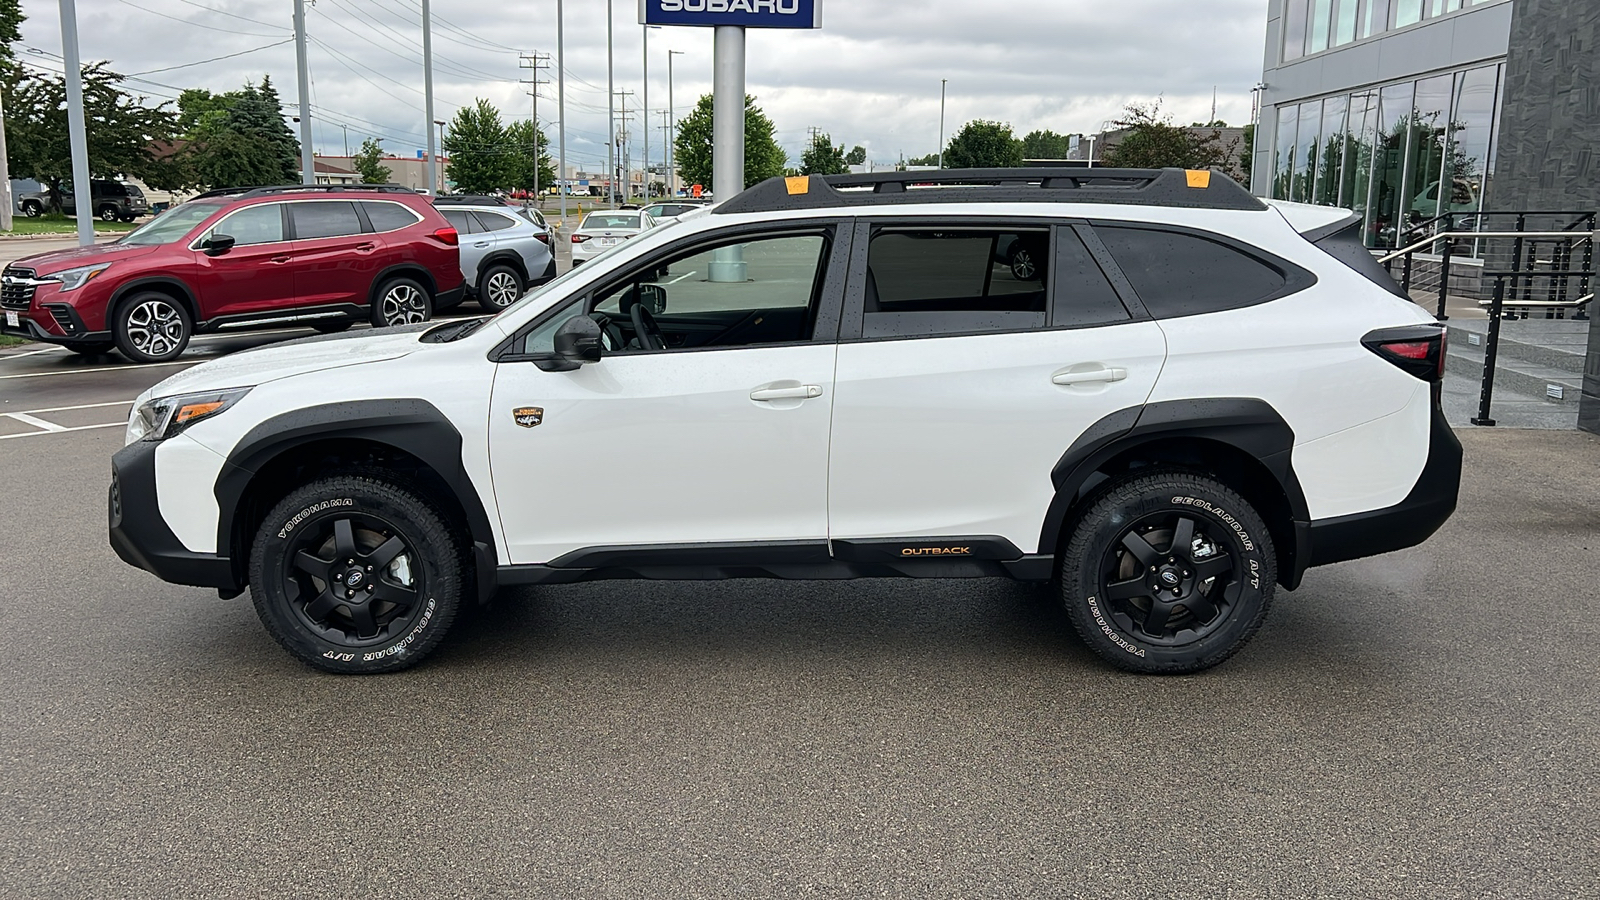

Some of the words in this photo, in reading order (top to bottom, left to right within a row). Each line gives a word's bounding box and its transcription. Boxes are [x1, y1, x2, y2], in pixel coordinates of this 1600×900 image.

[660, 0, 798, 14] SUBARU
[278, 499, 353, 538] YOKOHAMA
[901, 547, 970, 555] OUTBACK
[1171, 496, 1255, 551] GEOLANDAR
[1249, 559, 1259, 590] A/T
[363, 598, 436, 661] GEOLANDAR
[1087, 596, 1146, 658] YOKOHAMA
[323, 650, 355, 662] A/T
